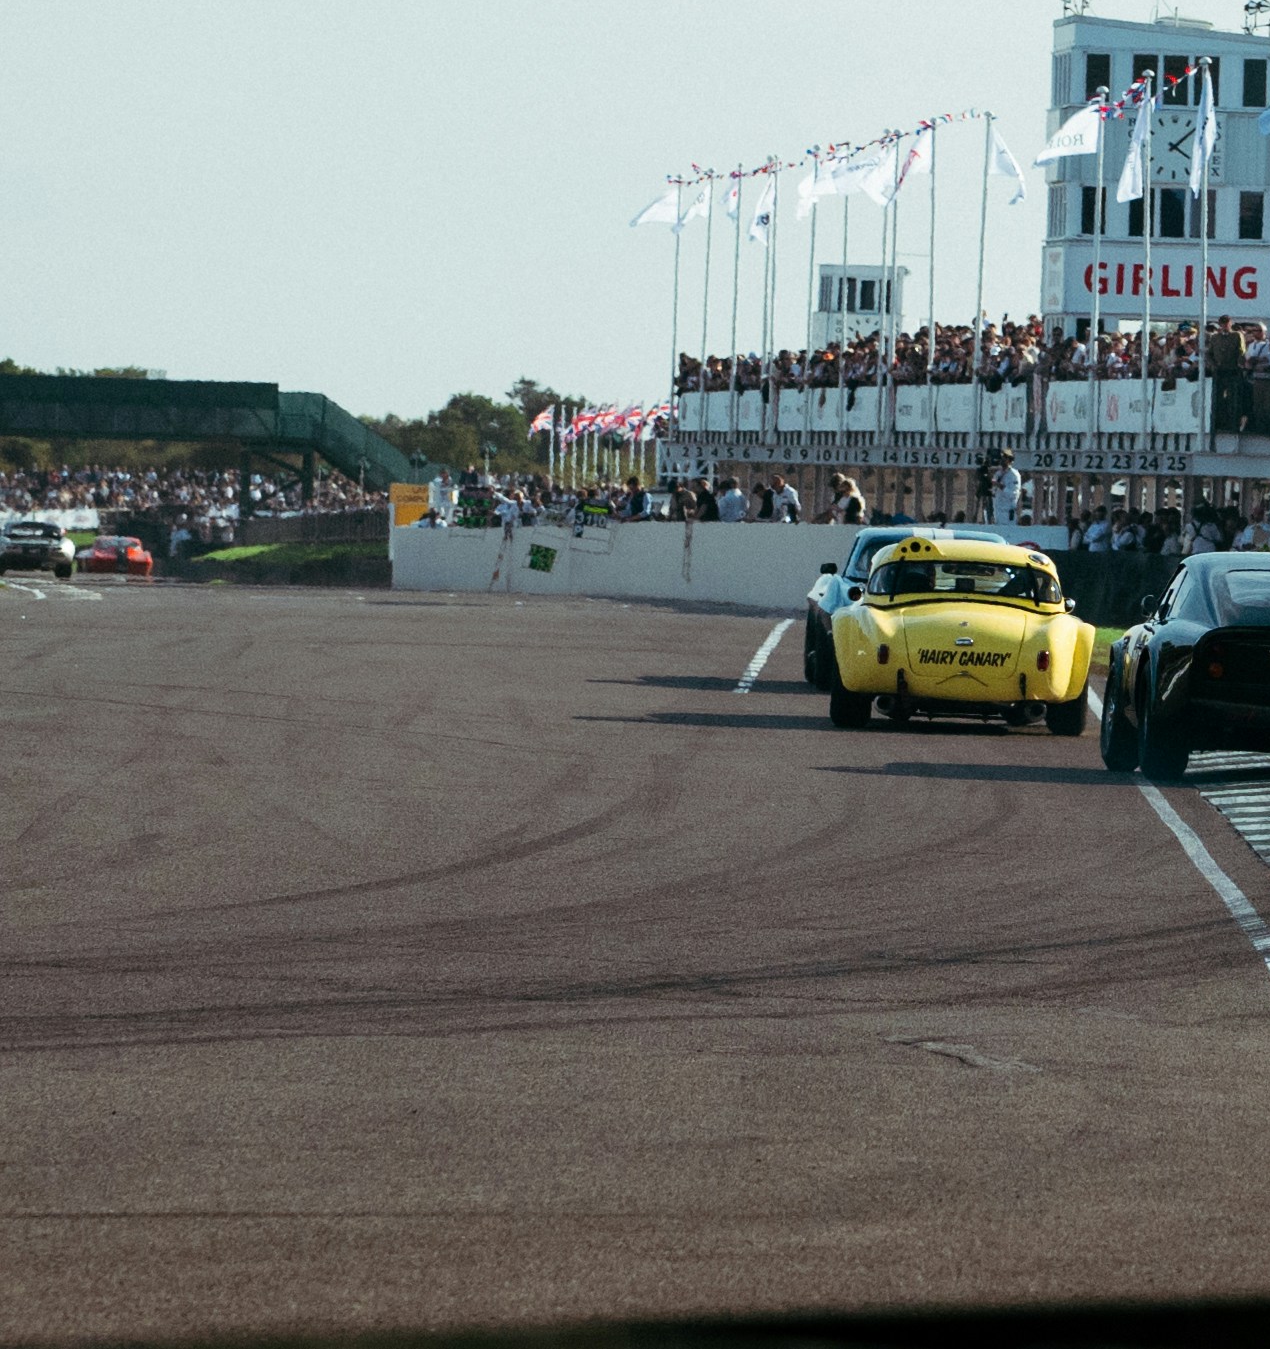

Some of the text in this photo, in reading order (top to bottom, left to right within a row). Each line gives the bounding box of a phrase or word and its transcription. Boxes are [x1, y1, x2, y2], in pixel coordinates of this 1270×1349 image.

[1084, 261, 1258, 300] GIRLING
[667, 448, 671, 458] 1
[683, 447, 690, 457] 2
[697, 448, 703, 457] 3
[711, 448, 719, 458] 4
[727, 448, 734, 458] 5
[743, 448, 750, 458] 6
[767, 449, 775, 459] 7
[783, 449, 791, 459] 8
[800, 449, 808, 460] 9
[816, 450, 832, 461] 10
[835, 450, 848, 461] 11
[854, 450, 869, 462] 12
[883, 451, 898, 463] 14
[903, 452, 919, 464] 15
[923, 453, 940, 465] 16
[945, 453, 961, 464] 17
[1034, 454, 1052, 467] 20
[1060, 455, 1077, 467] 21
[1084, 455, 1104, 469] 22
[1111, 455, 1131, 469] 23
[1138, 455, 1159, 470] 24
[1167, 456, 1187, 470] 25
